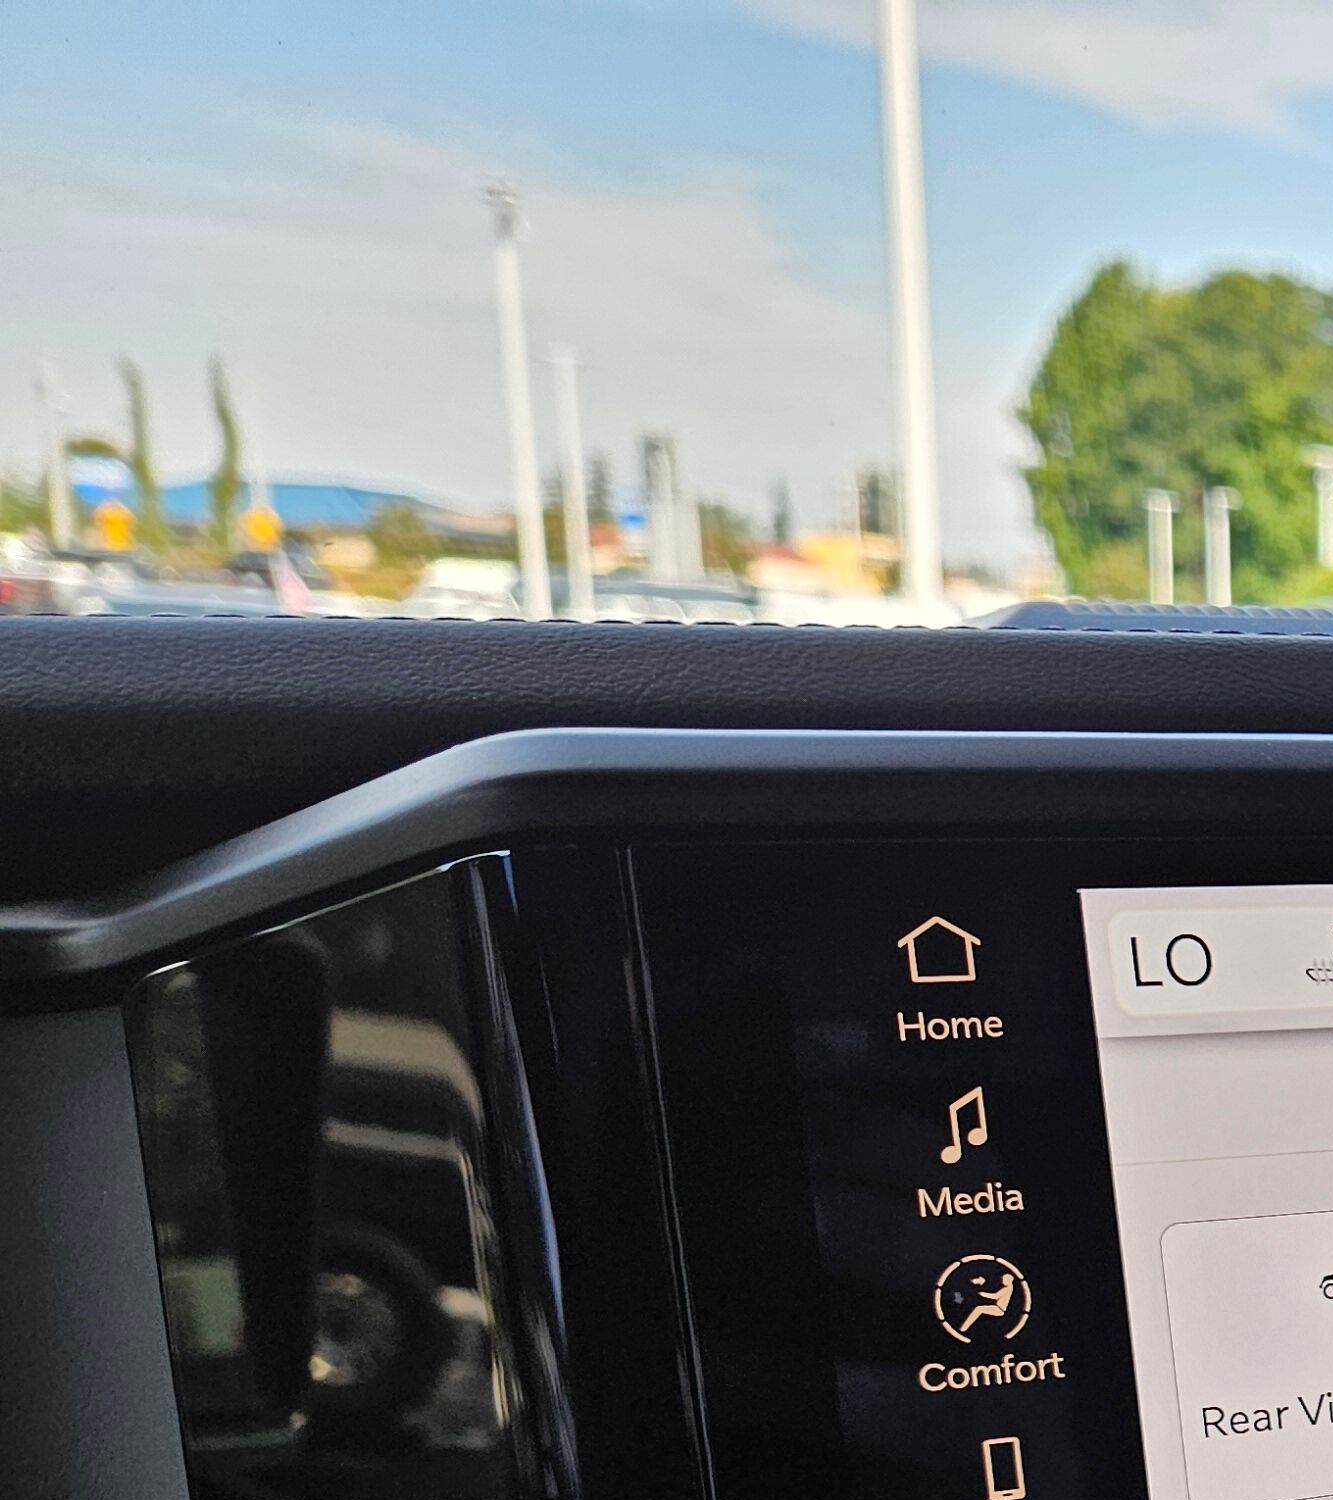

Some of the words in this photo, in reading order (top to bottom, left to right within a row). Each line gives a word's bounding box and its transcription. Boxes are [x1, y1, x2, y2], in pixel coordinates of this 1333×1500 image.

[1130, 933, 1213, 987] LO
[897, 1011, 1004, 1042] Home
[917, 1181, 1025, 1218] Media
[918, 1352, 1066, 1392] Comfort
[1202, 1406, 1289, 1439] Rear
